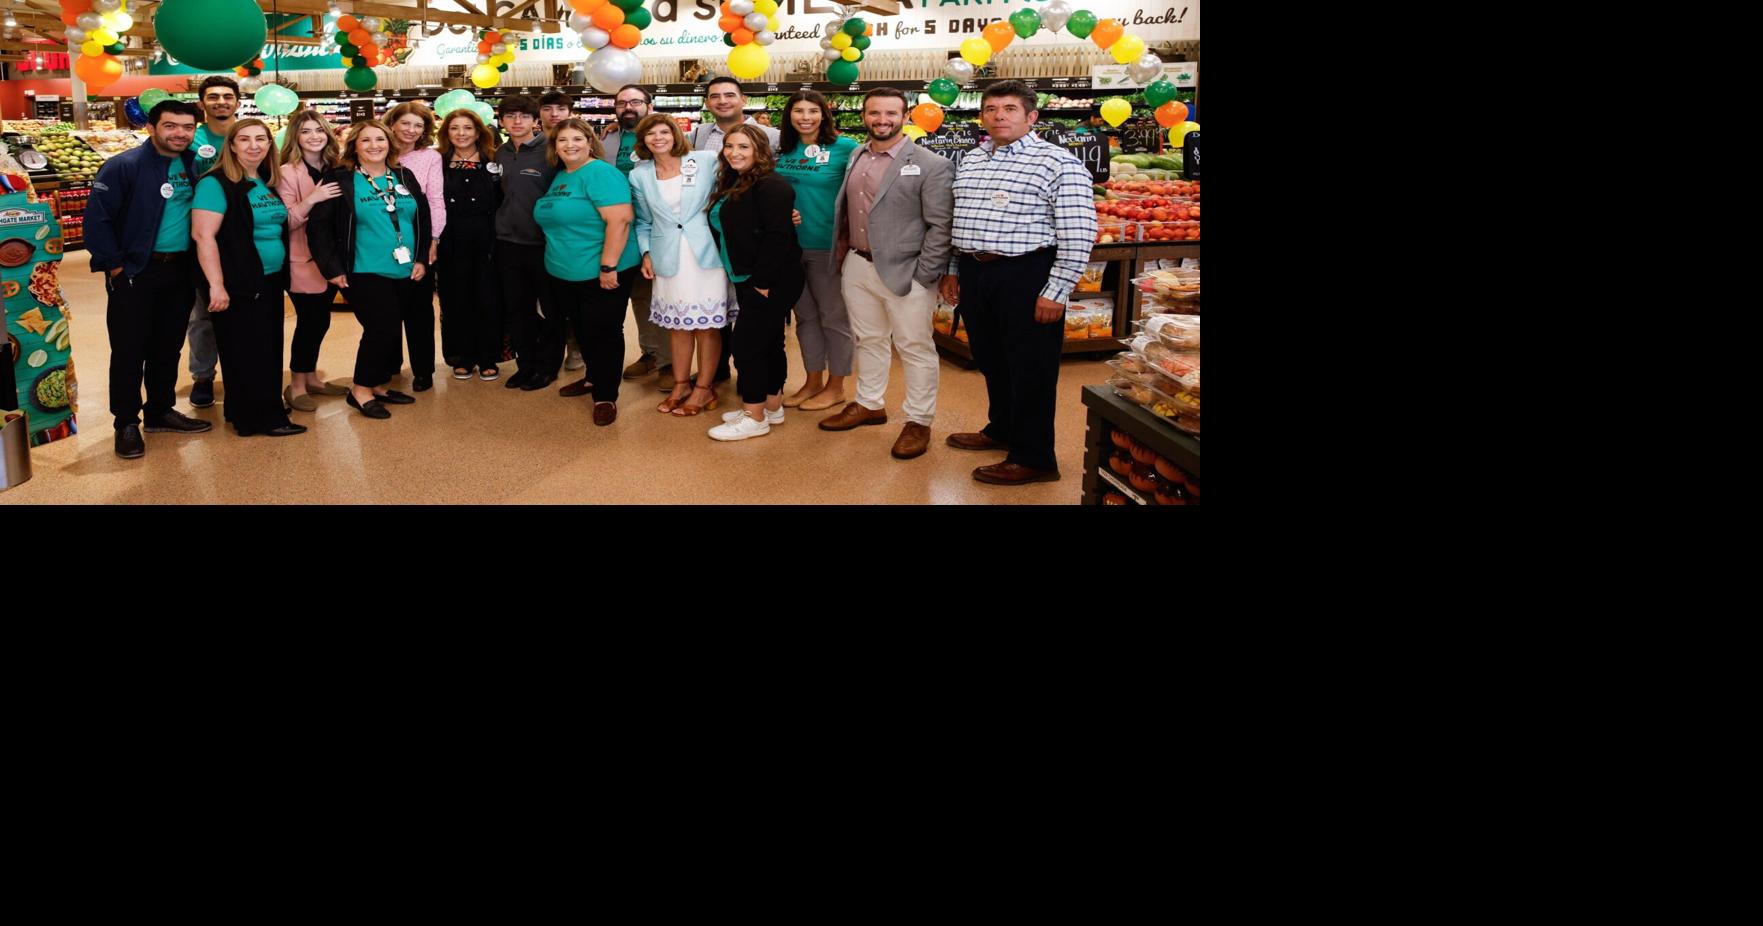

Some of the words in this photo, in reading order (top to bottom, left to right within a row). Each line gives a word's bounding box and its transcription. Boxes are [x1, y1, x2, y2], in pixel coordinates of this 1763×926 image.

[895, 21, 920, 39] for
[924, 20, 937, 34] 5
[949, 17, 1002, 33] DAY
[1133, 7, 1188, 25] back!
[519, 39, 528, 50] 5
